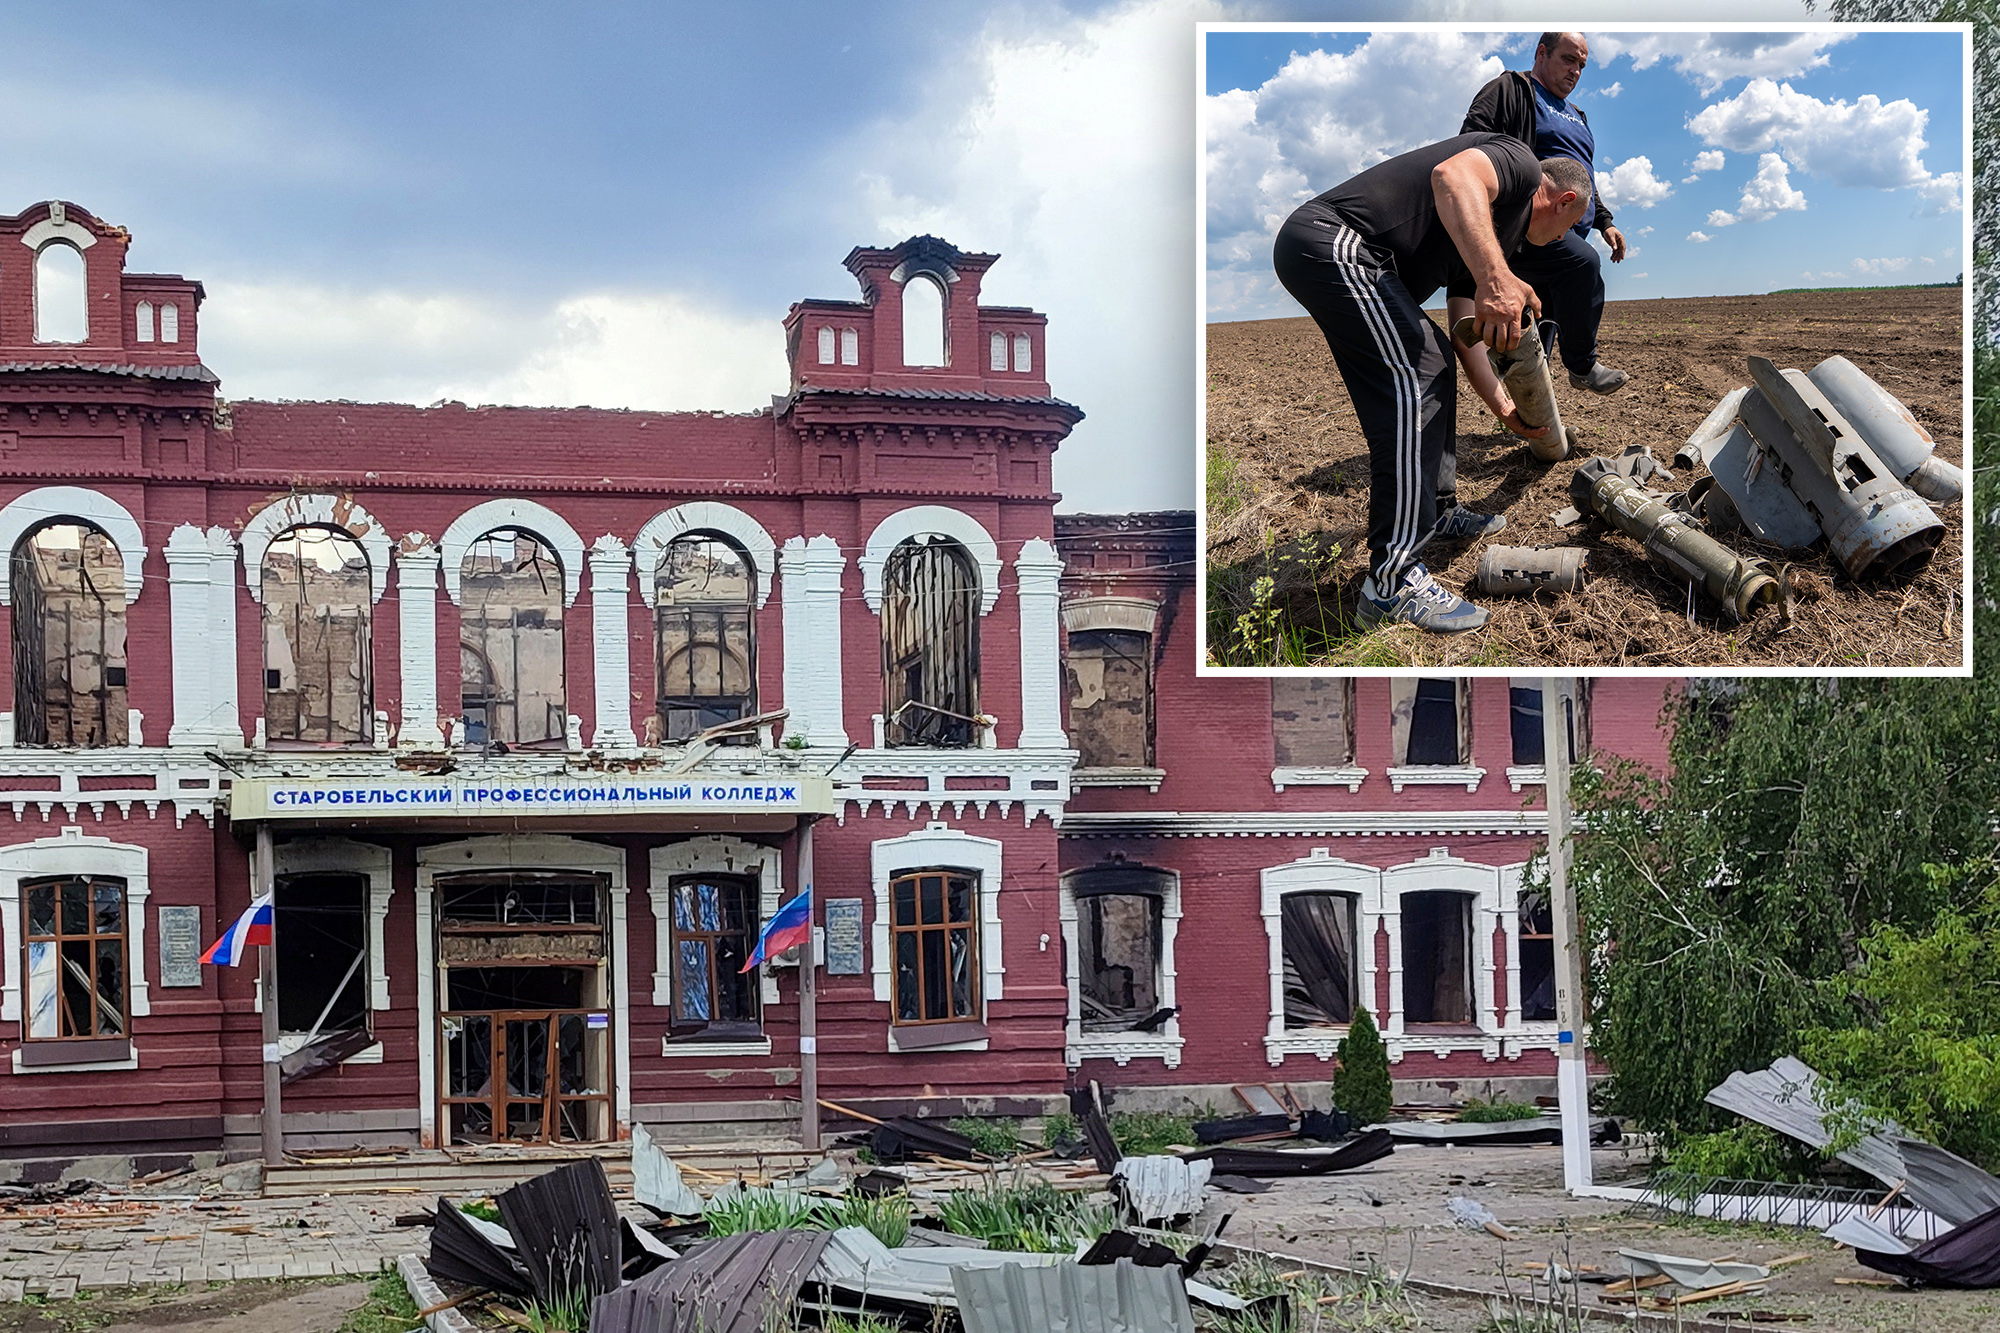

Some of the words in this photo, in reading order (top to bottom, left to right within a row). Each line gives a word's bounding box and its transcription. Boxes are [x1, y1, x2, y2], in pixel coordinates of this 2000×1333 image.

[273, 785, 451, 804] СТАРОБЕЛЬСКИЙ
[463, 784, 692, 803] ПРОФЕССИОНАЛЬНЫЙ
[702, 786, 796, 802] КОЛЛЕДЖ
